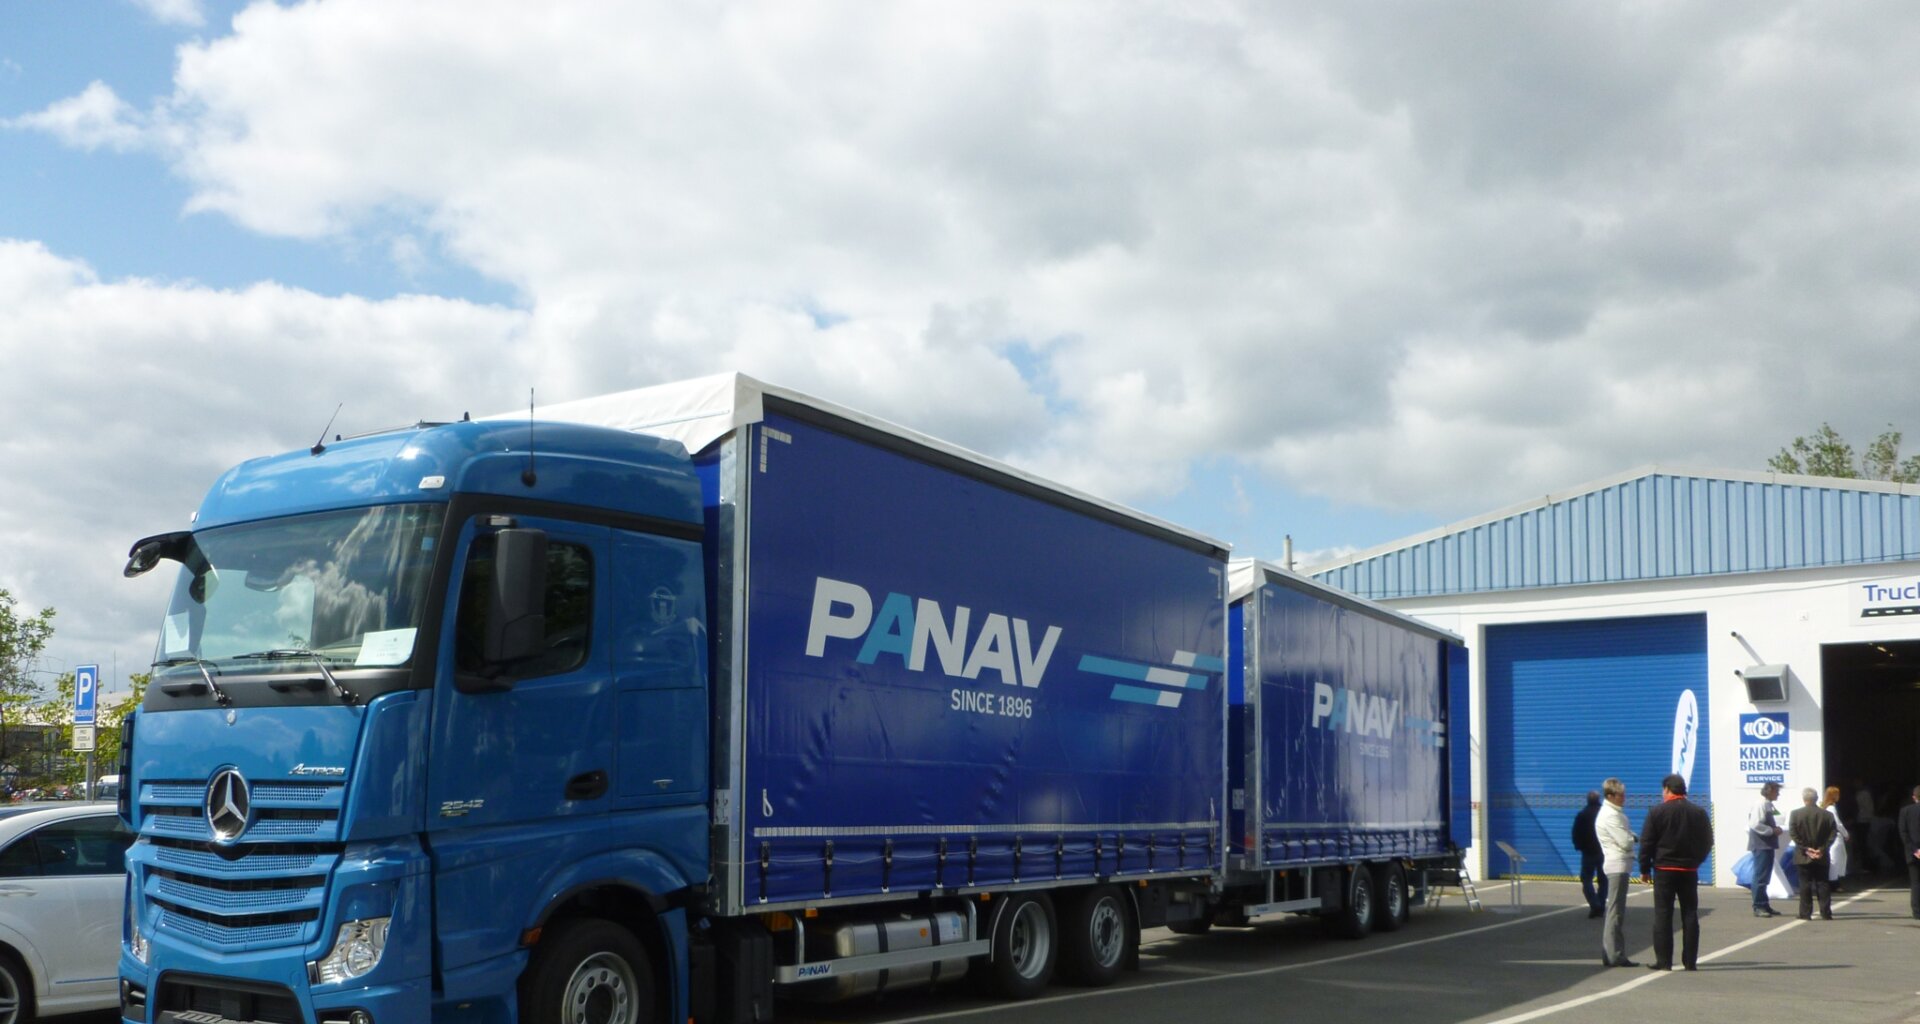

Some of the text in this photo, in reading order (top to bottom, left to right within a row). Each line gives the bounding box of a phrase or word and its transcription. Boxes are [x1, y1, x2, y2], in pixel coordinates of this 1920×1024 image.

[1862, 582, 1920, 601] Truc
[805, 576, 1063, 689] PANAV
[78, 673, 91, 705] P
[951, 688, 1032, 719] SINCE 1896
[1312, 682, 1398, 739] PANAV
[1740, 747, 1789, 759] KNORR
[1740, 760, 1790, 771] BREMSE
[798, 964, 831, 977] PANAV
